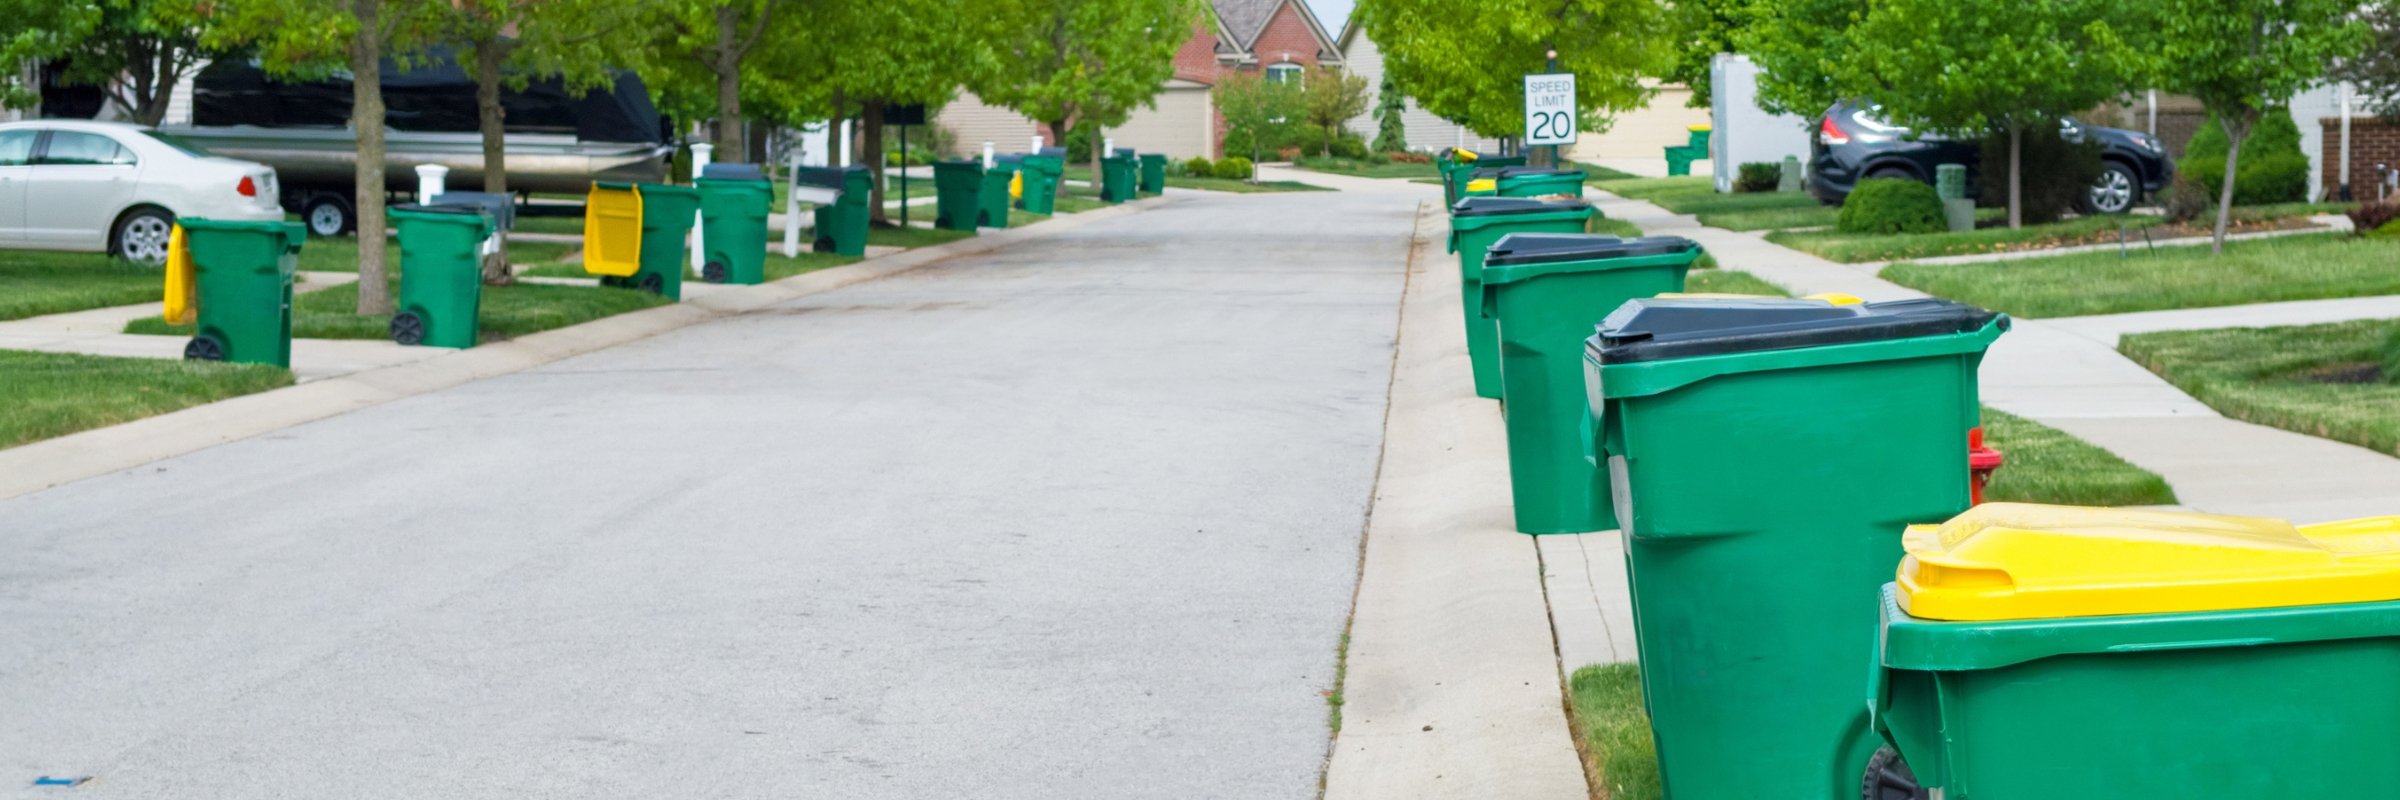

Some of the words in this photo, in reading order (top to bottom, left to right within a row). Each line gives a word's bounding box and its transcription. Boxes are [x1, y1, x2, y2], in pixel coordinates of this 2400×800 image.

[1530, 80, 1571, 93] SPEED
[1534, 95, 1566, 107] LIMIT
[1533, 111, 1570, 139] 20
